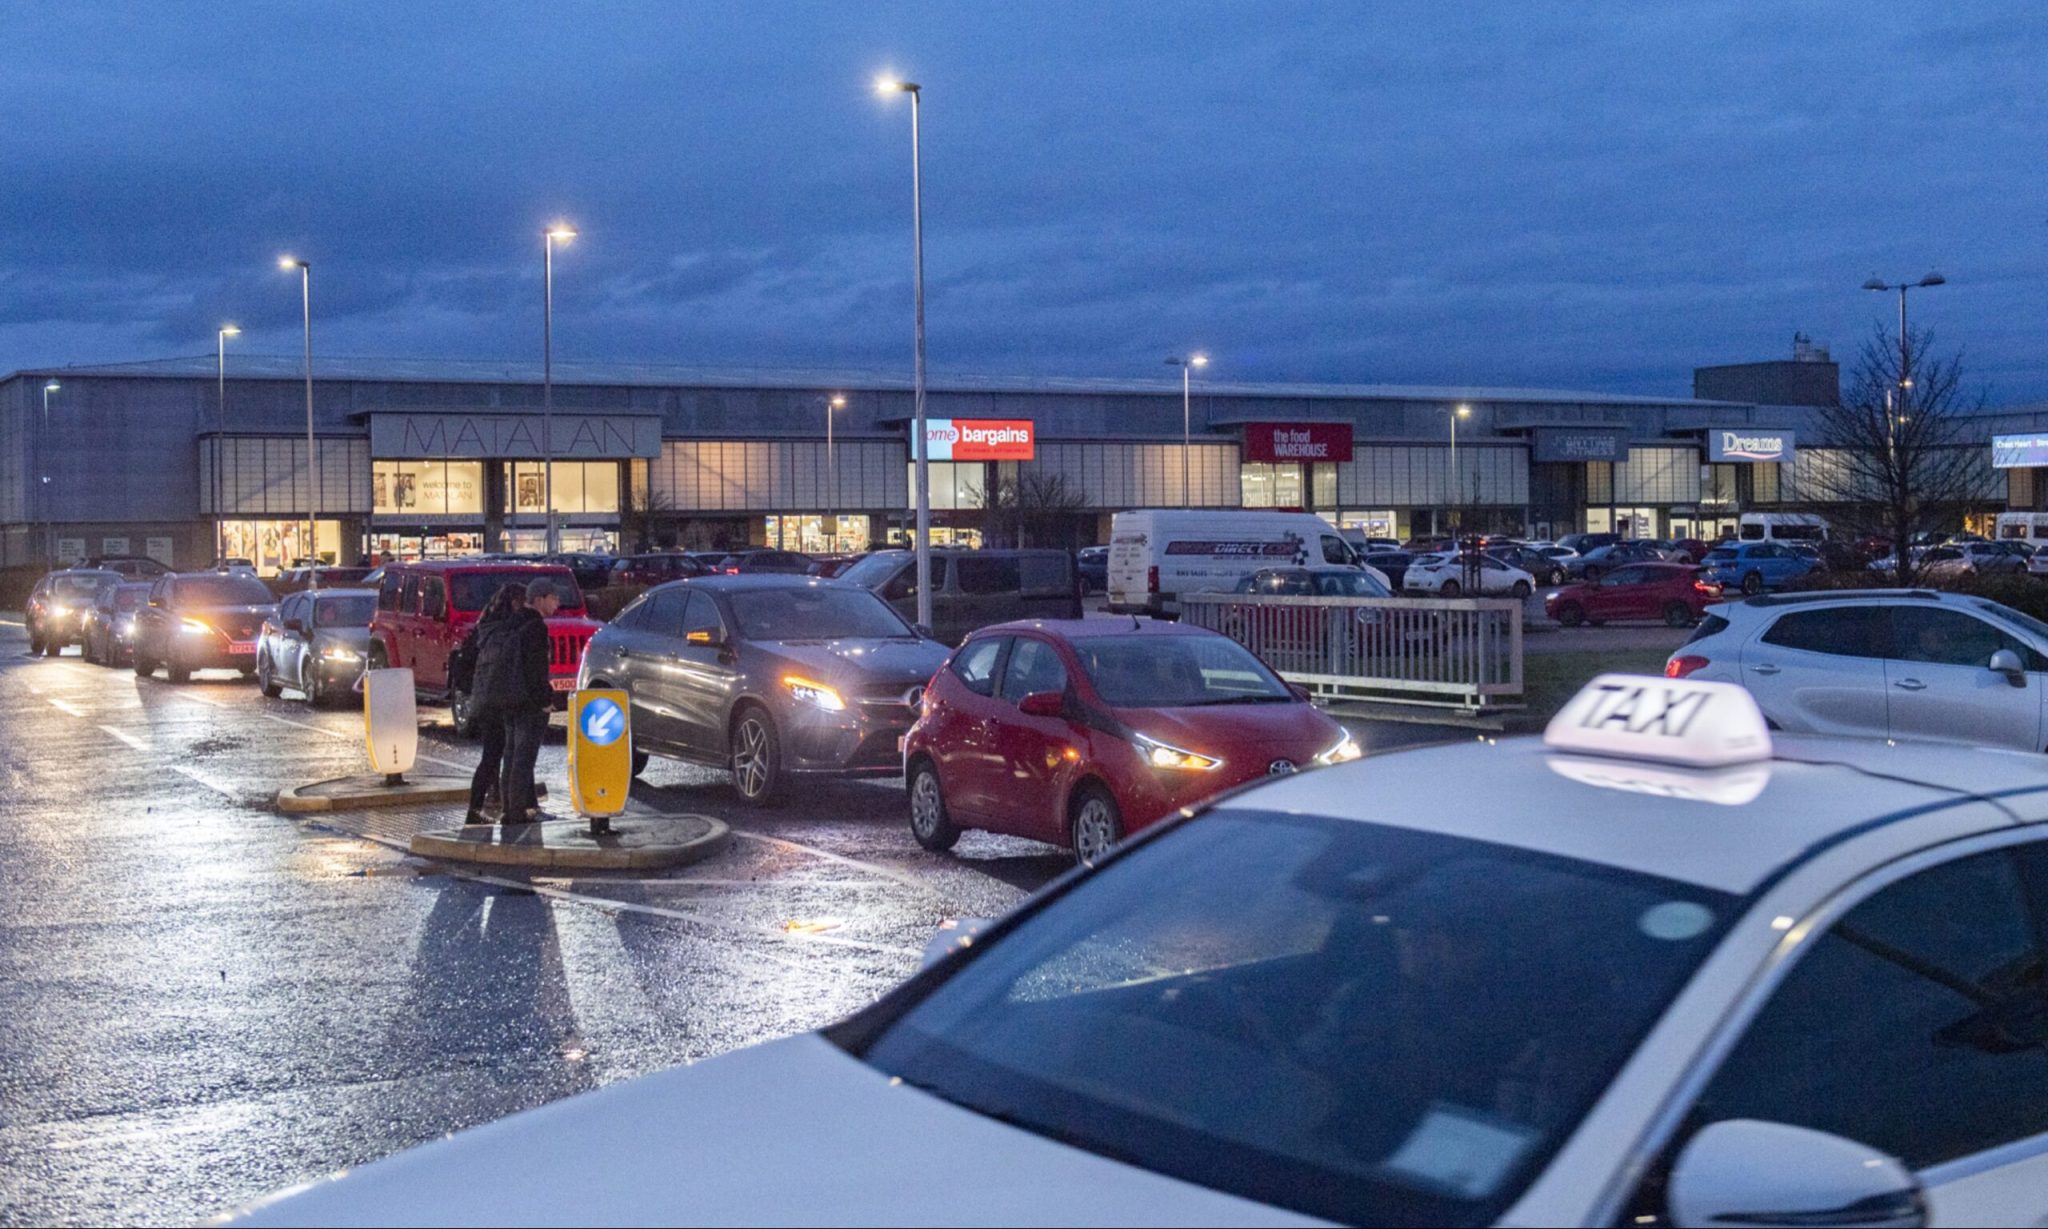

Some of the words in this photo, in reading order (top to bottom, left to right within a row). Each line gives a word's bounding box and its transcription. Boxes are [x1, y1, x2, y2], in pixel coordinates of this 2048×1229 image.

[403, 417, 637, 454] MATALAN
[926, 429, 956, 441] ome
[962, 425, 1029, 446] bargains
[1273, 429, 1289, 443] the
[1290, 429, 1311, 444] food
[1722, 431, 1783, 452] Dreams
[1273, 443, 1328, 457] WAREHOUSE
[463, 480, 472, 489] to
[1578, 684, 1715, 738] TAXI
